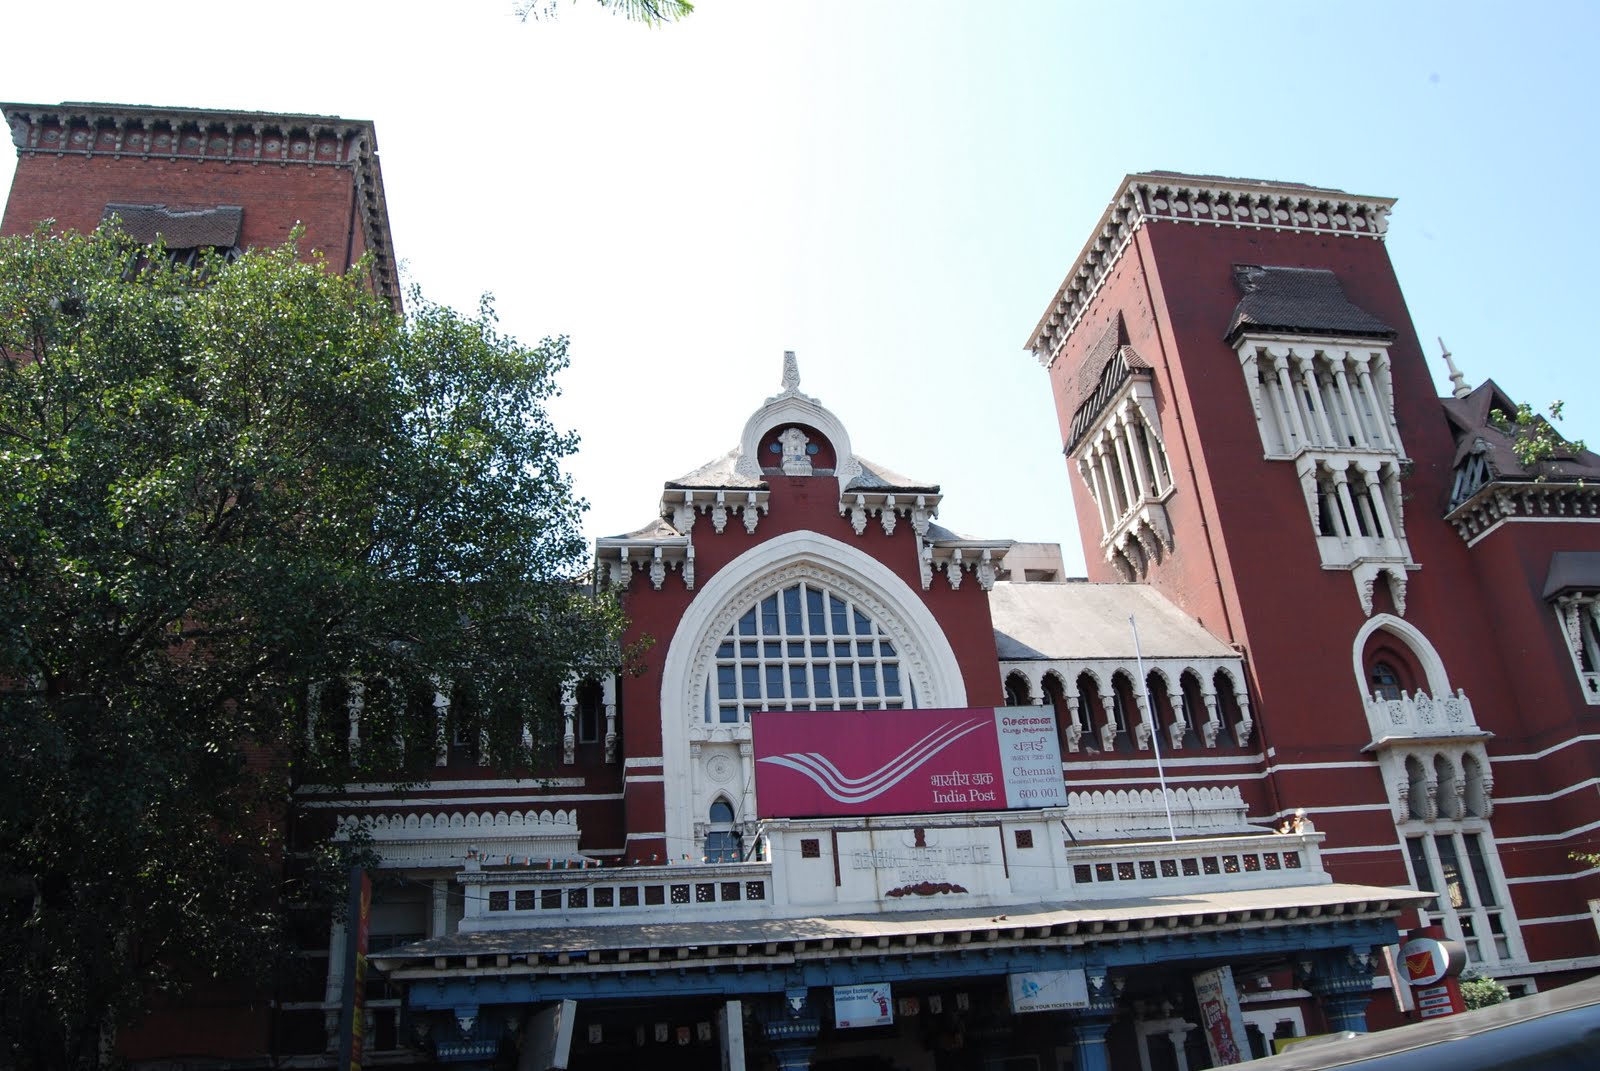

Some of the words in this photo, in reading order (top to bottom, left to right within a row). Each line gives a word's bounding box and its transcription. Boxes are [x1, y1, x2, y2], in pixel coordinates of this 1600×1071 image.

[1002, 716, 1051, 726] சென்னை
[1012, 766, 1056, 777] Chennai
[931, 770, 970, 786] भारतीय
[972, 772, 994, 785] डाक
[933, 790, 967, 803] India
[969, 789, 995, 802] Post
[1019, 789, 1038, 799] 600
[1041, 788, 1059, 798] 001
[853, 987, 875, 995] Exchange
